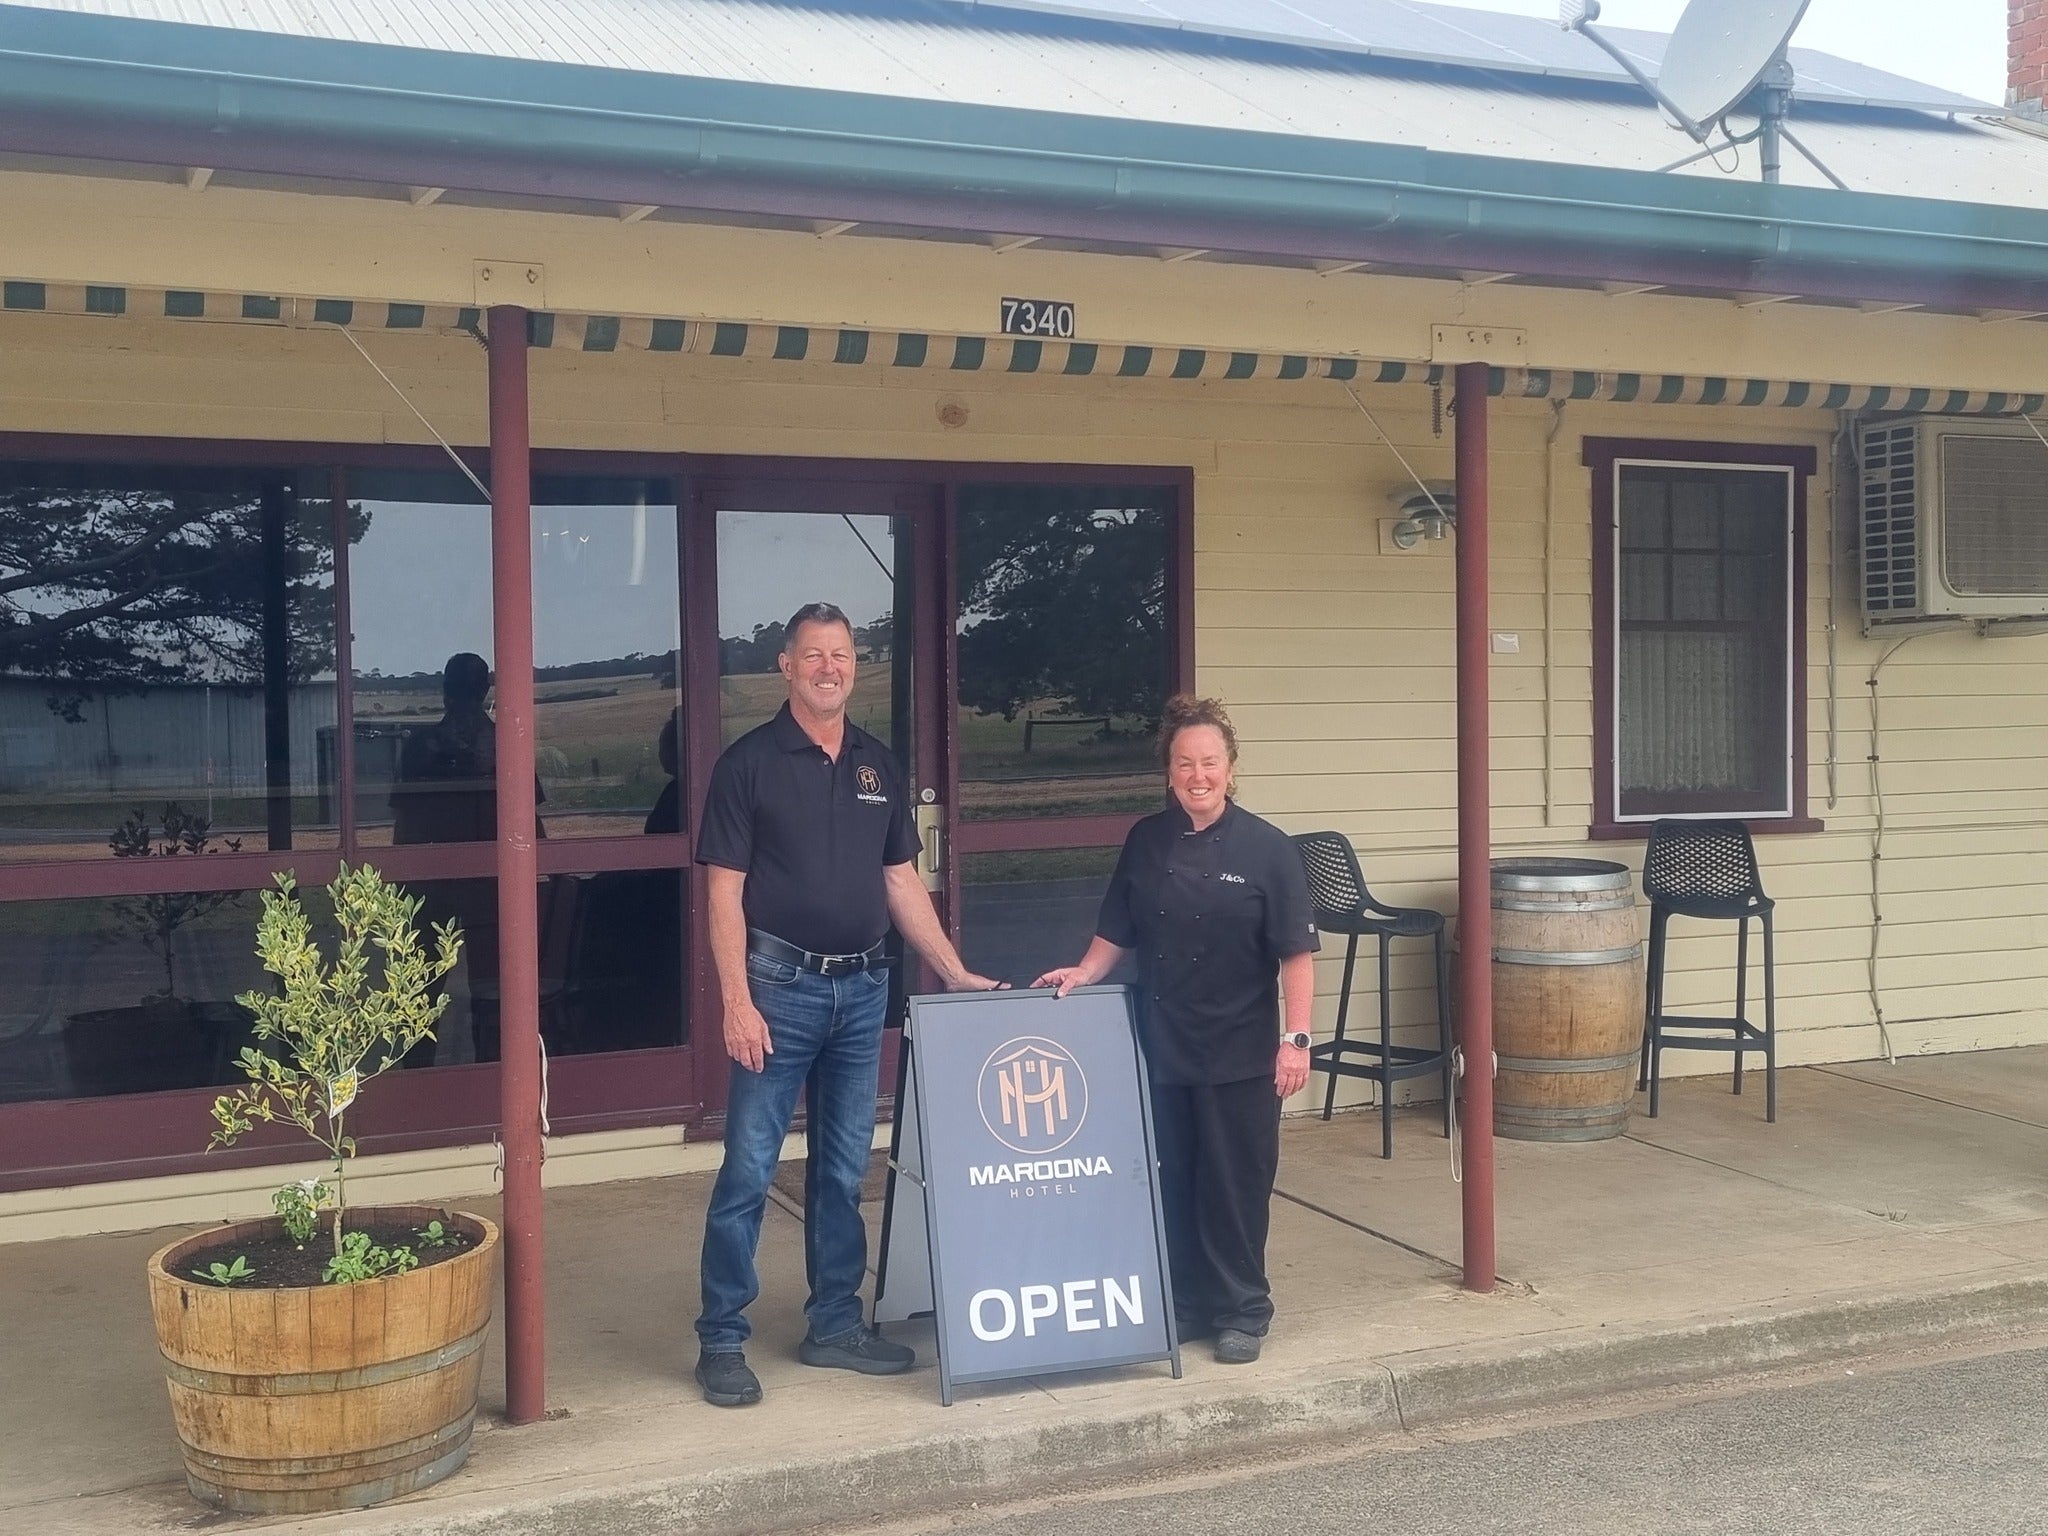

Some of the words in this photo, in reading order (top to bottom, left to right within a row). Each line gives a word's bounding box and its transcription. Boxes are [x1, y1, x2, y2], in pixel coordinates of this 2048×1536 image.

[1002, 300, 1074, 338] 7340
[1219, 873, 1246, 884] J&Co
[969, 1156, 1113, 1186] MAROONA
[1010, 1183, 1077, 1199] HOTEL
[969, 1275, 1145, 1342] OPEN
